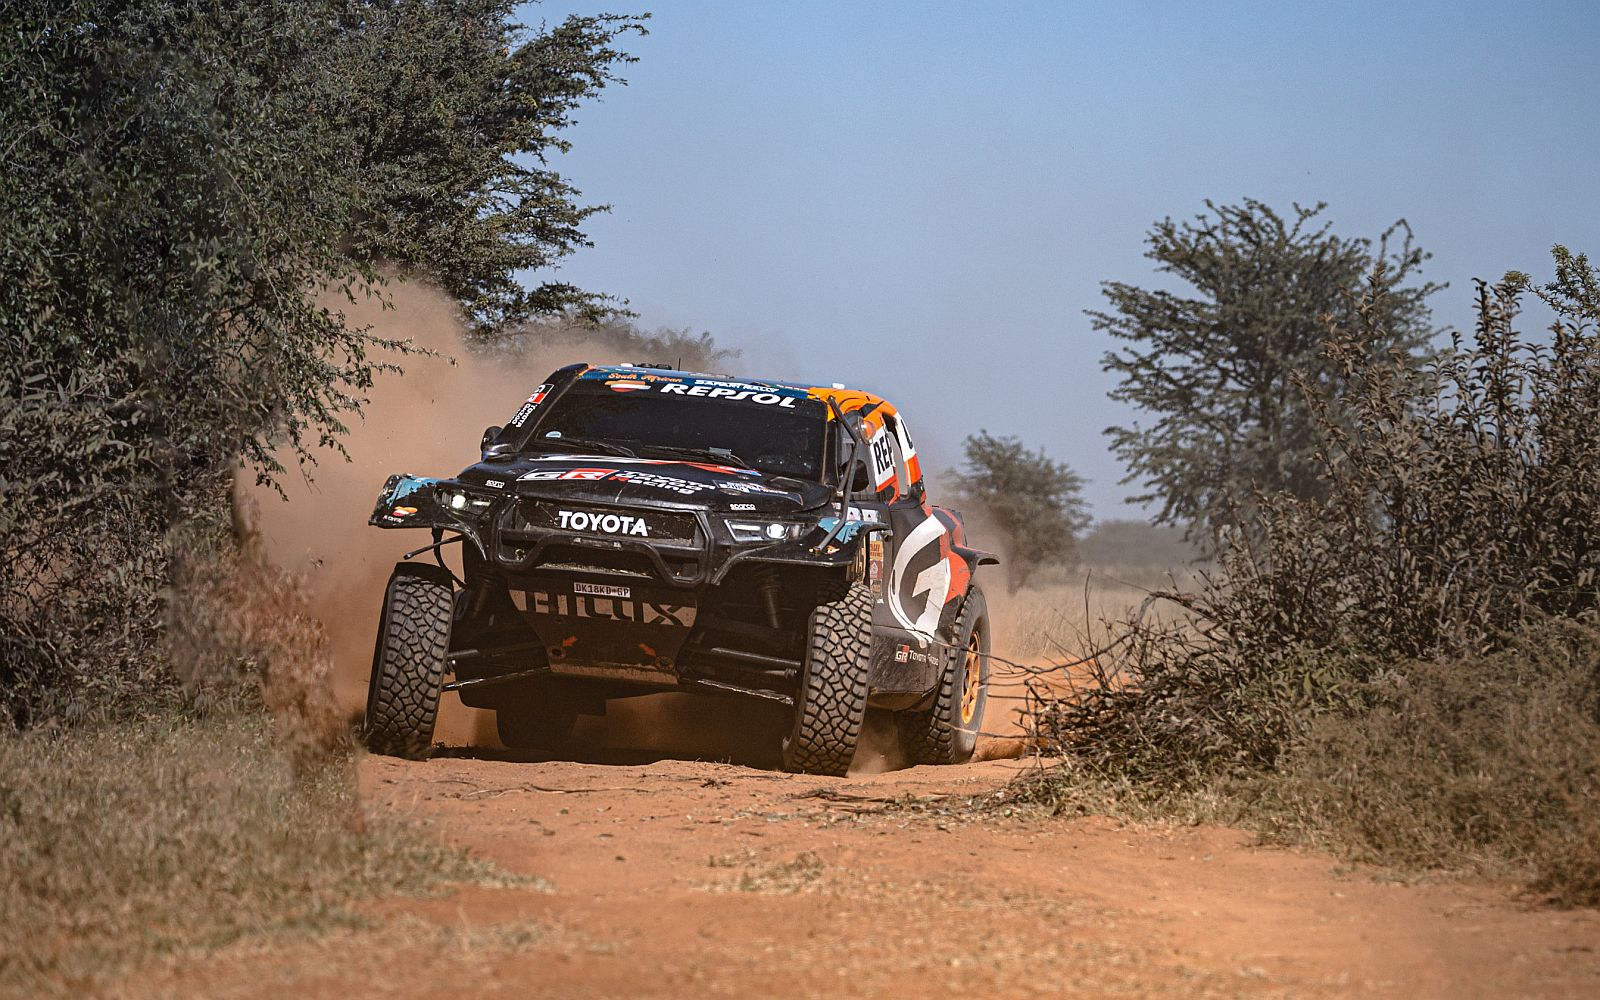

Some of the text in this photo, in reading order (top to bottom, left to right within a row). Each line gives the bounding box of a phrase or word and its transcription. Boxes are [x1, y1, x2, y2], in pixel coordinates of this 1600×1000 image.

[660, 383, 796, 408] REPSOL
[520, 469, 607, 481] GR
[558, 510, 648, 537] TOYOTA
[895, 650, 908, 662] GR
